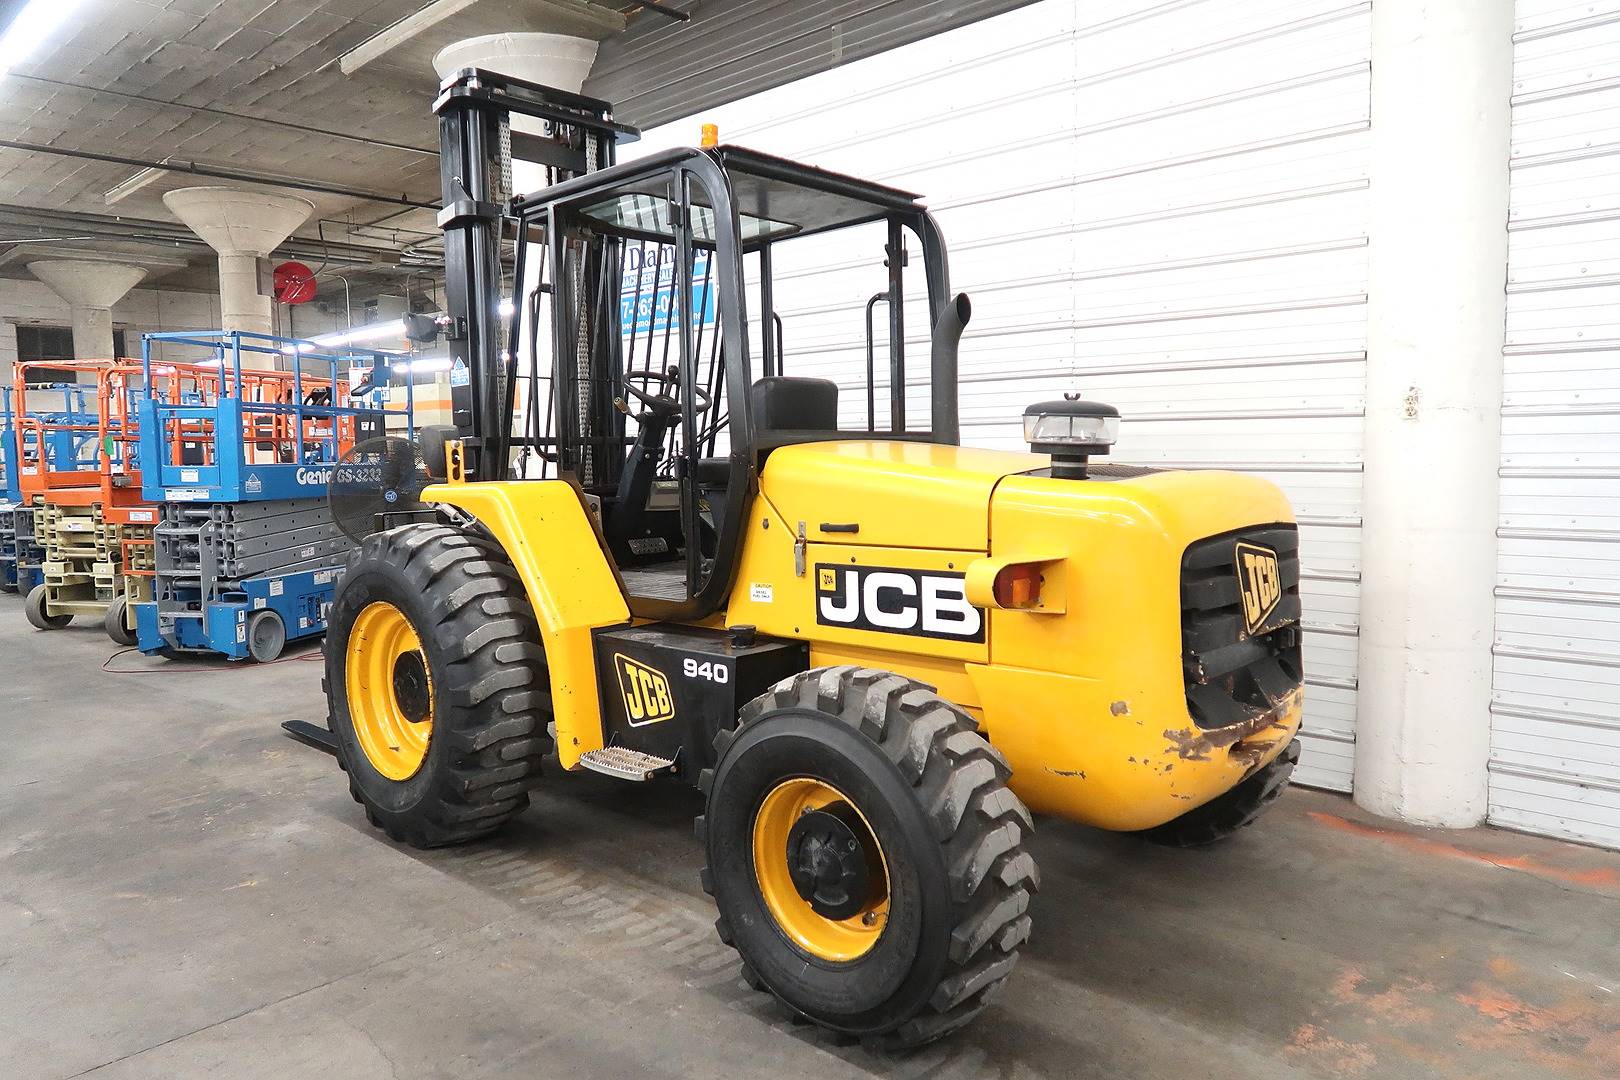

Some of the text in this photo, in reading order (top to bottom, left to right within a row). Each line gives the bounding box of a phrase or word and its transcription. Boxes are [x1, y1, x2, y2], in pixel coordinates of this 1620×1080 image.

[296, 467, 333, 485] Genie
[820, 570, 981, 636] JCB
[1244, 553, 1279, 625] JCB
[624, 662, 671, 719] JCB
[683, 657, 729, 684] 940
